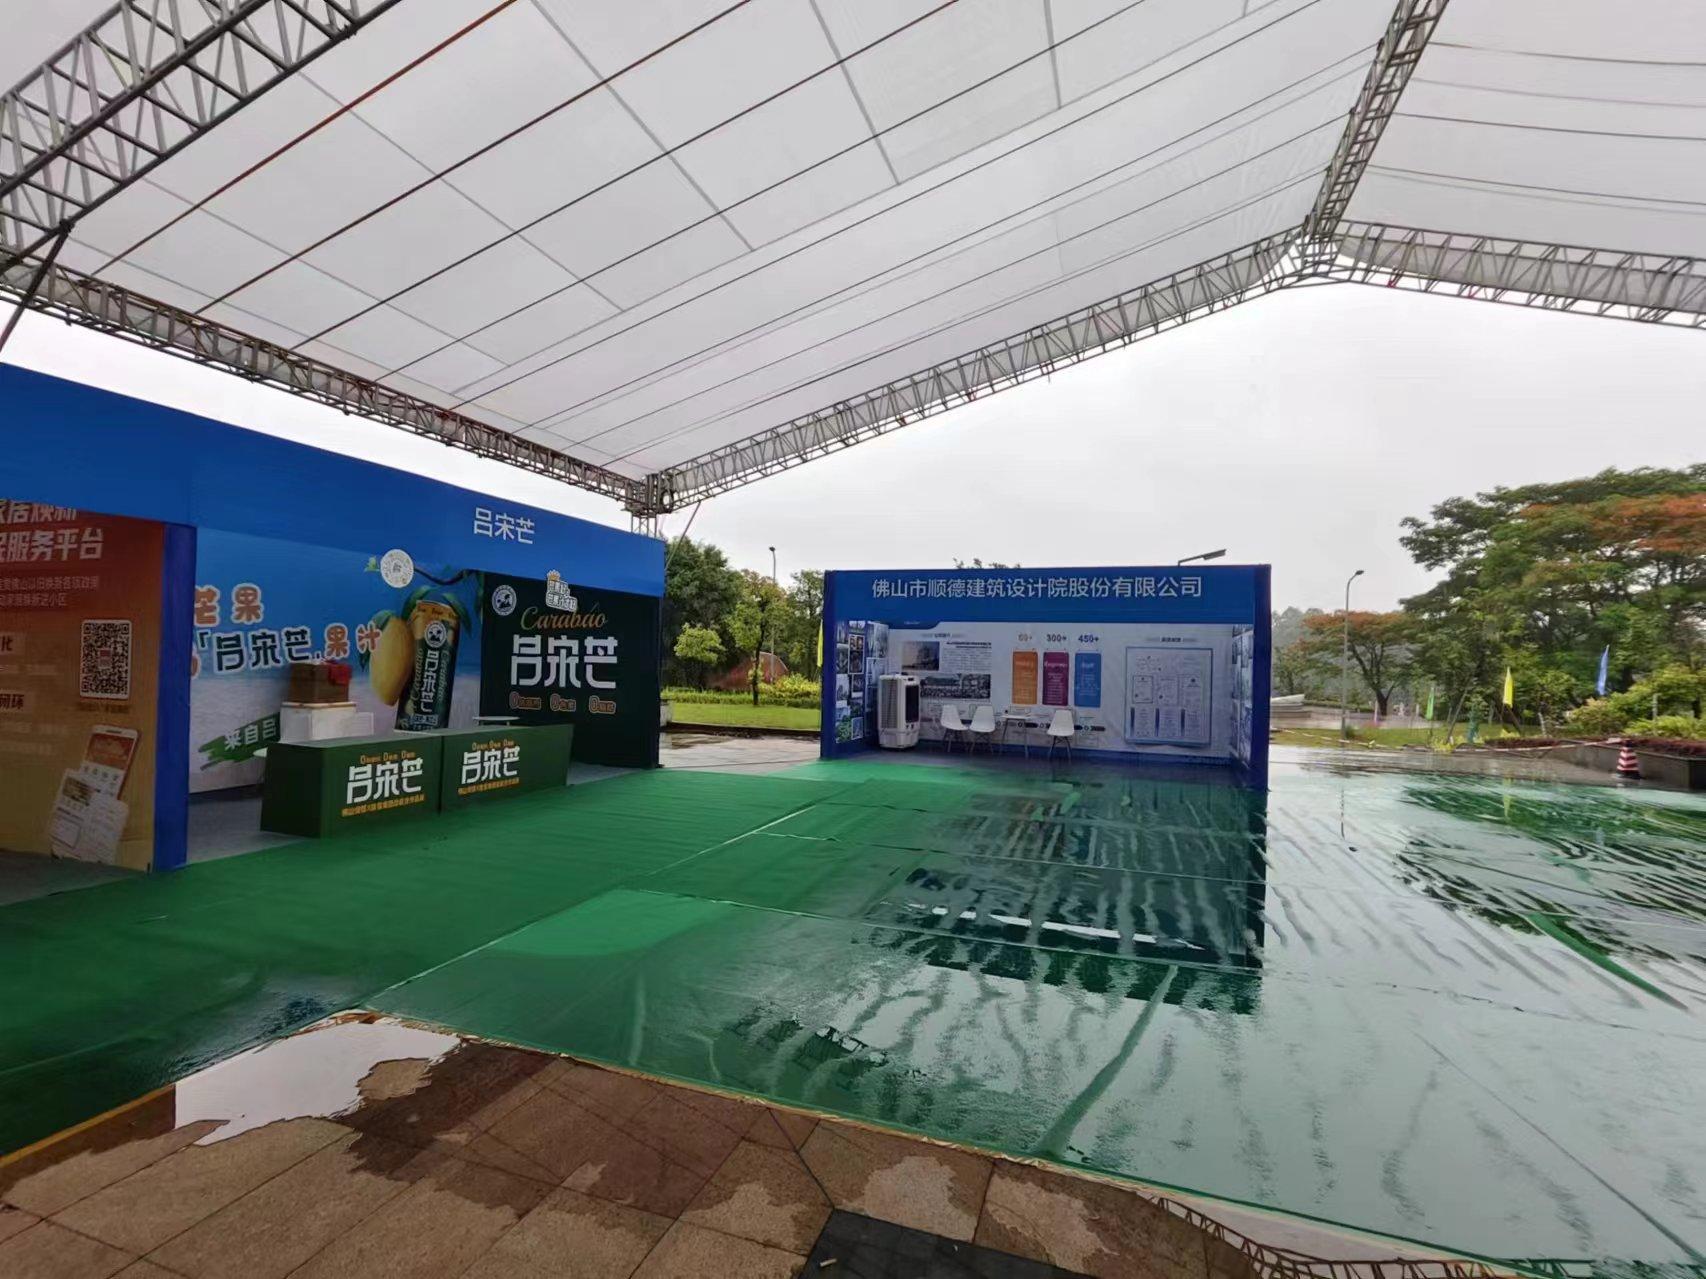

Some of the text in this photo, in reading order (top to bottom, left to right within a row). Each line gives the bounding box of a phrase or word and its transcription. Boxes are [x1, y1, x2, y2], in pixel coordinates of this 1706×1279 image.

[473, 507, 535, 544] 吕宋芒
[194, 584, 262, 625] 芒果
[872, 577, 1203, 600] 佛山市顺德建筑设计院股份有限公司
[1078, 634, 1099, 643] 450+
[511, 634, 618, 689] 吕宋芒
[224, 718, 276, 751] 来自吕
[346, 757, 424, 805] 吕宋芒
[461, 746, 521, 785] 吕宋芒
